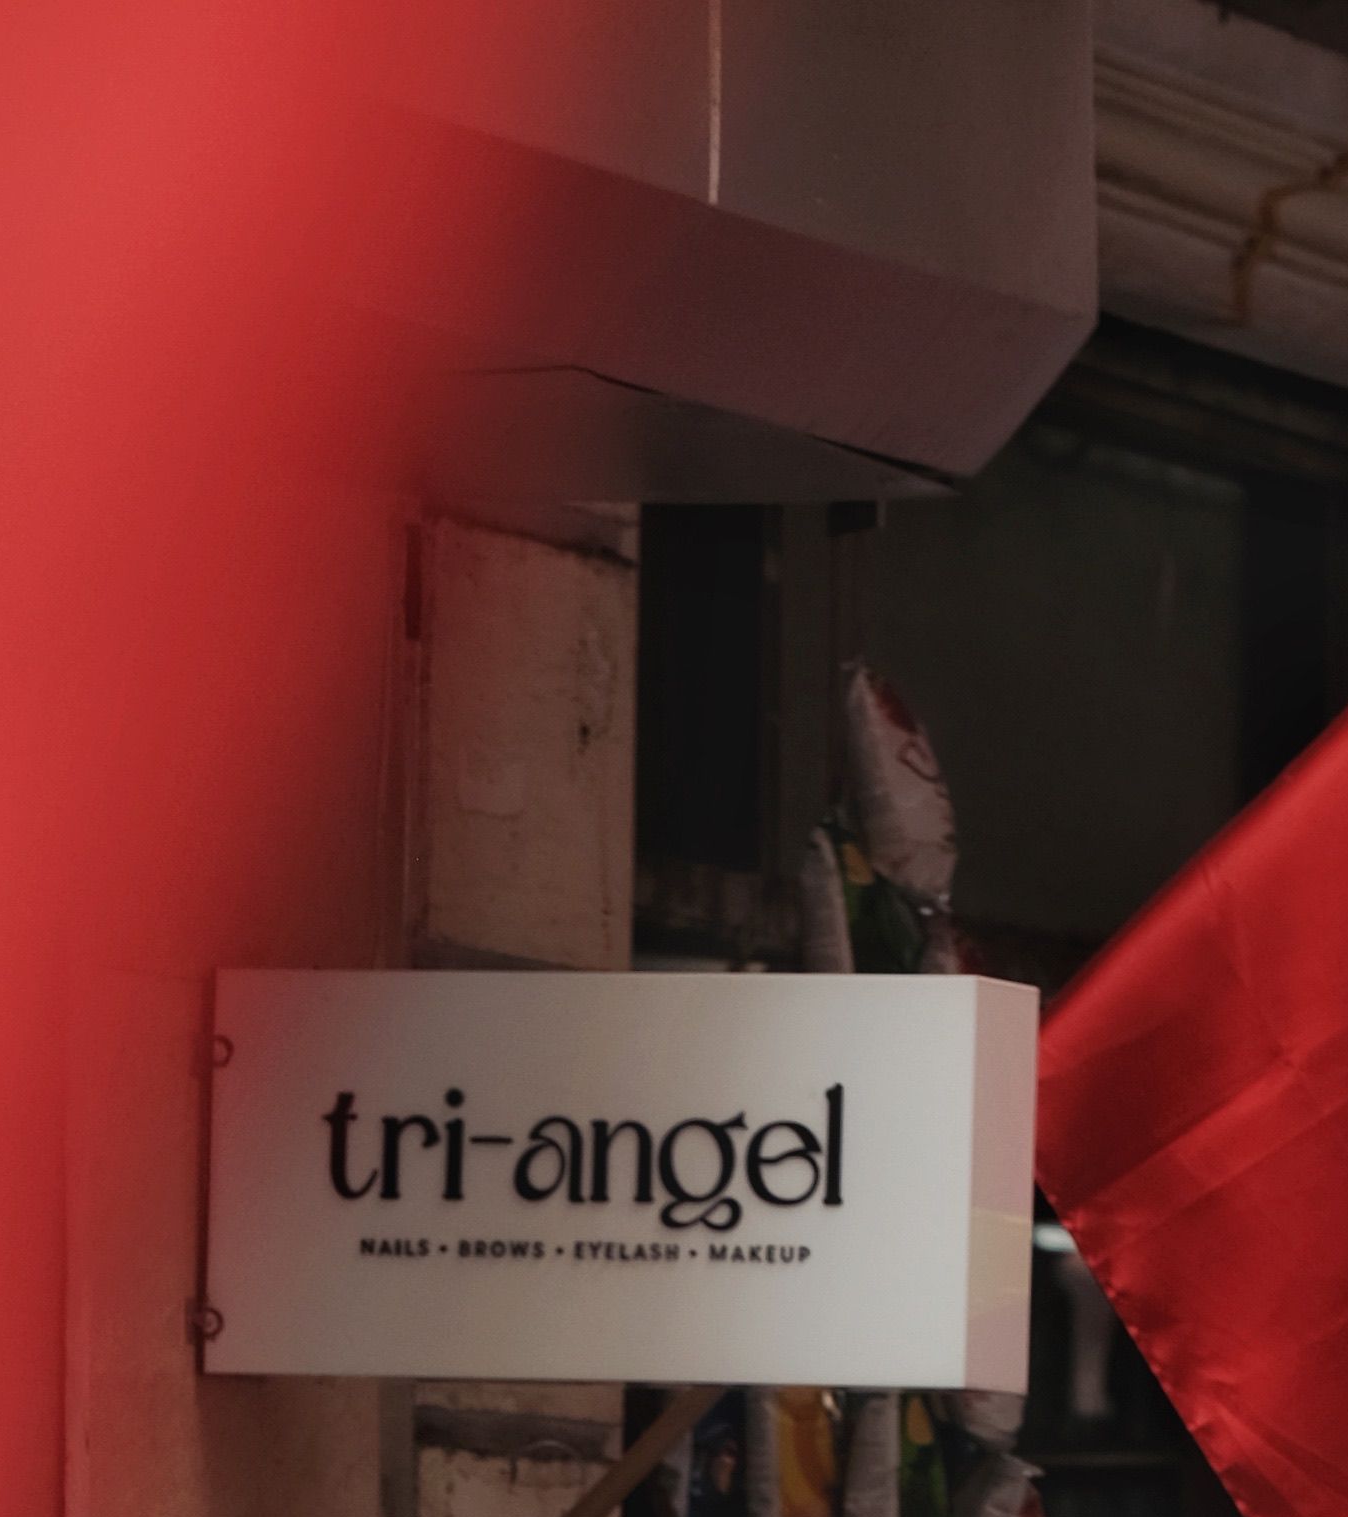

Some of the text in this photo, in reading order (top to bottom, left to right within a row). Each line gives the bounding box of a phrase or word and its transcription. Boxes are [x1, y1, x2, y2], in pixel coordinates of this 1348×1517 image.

[322, 1083, 845, 1231] tri-angel
[359, 1238, 812, 1264] NAILS BROWS EYELASH MAKEUP
